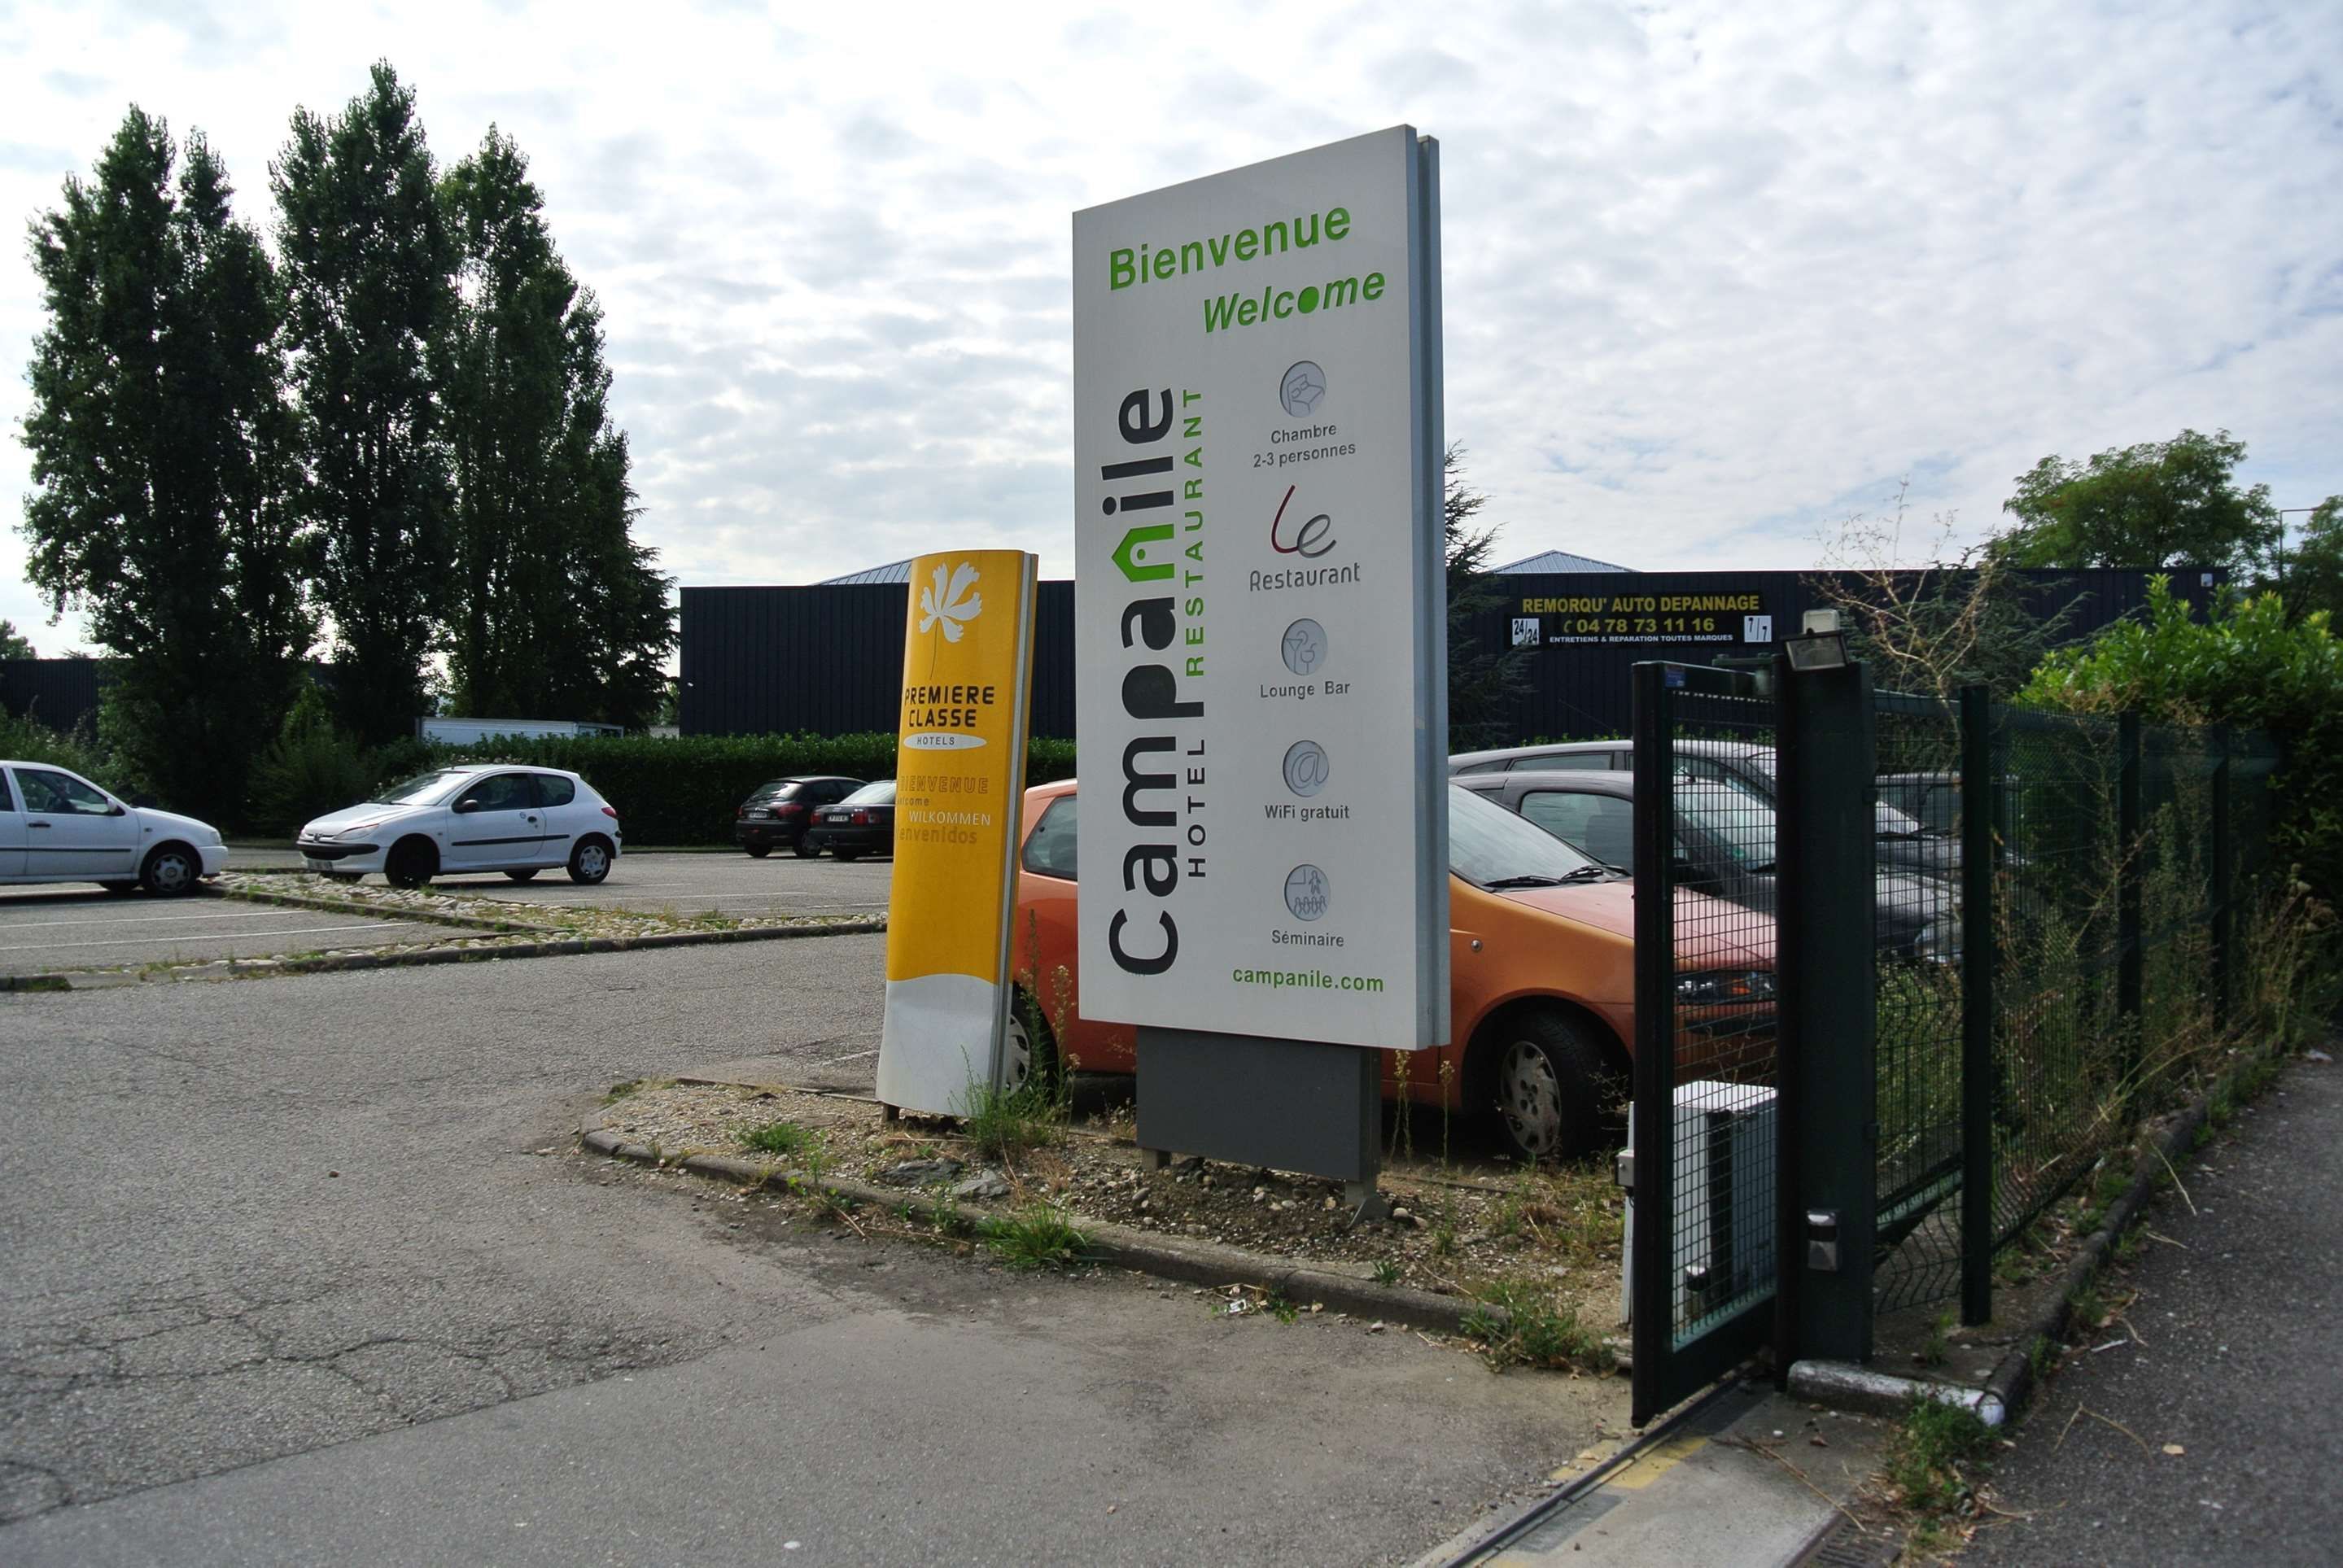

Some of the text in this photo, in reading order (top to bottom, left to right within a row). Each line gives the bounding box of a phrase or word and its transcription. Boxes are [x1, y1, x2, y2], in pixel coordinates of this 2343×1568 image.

[1109, 207, 1351, 291] Bienvenue
[1204, 271, 1385, 334] Welcome
[1270, 424, 1337, 444] Chambre
[1253, 443, 1356, 468] 2-3 personnes
[1250, 561, 1361, 592] Restaurant
[1523, 596, 1759, 613] REMORQU' AUTO DEPANNAGE
[1182, 388, 1206, 878] HOTEL RESTAURANT
[1576, 618, 1715, 633] 04 78 73 11 16
[1609, 635, 1659, 643] REPARATION
[904, 685, 994, 705] PREMIERE
[1260, 680, 1351, 700] Lounge Bar
[909, 709, 976, 727] CLASSE
[917, 736, 955, 745] HOTELS
[909, 810, 990, 826] WILKOMMEN
[1265, 805, 1350, 823] WiFi gratuit
[1271, 929, 1344, 948] Séminaire
[1232, 968, 1384, 993] campanile.com
